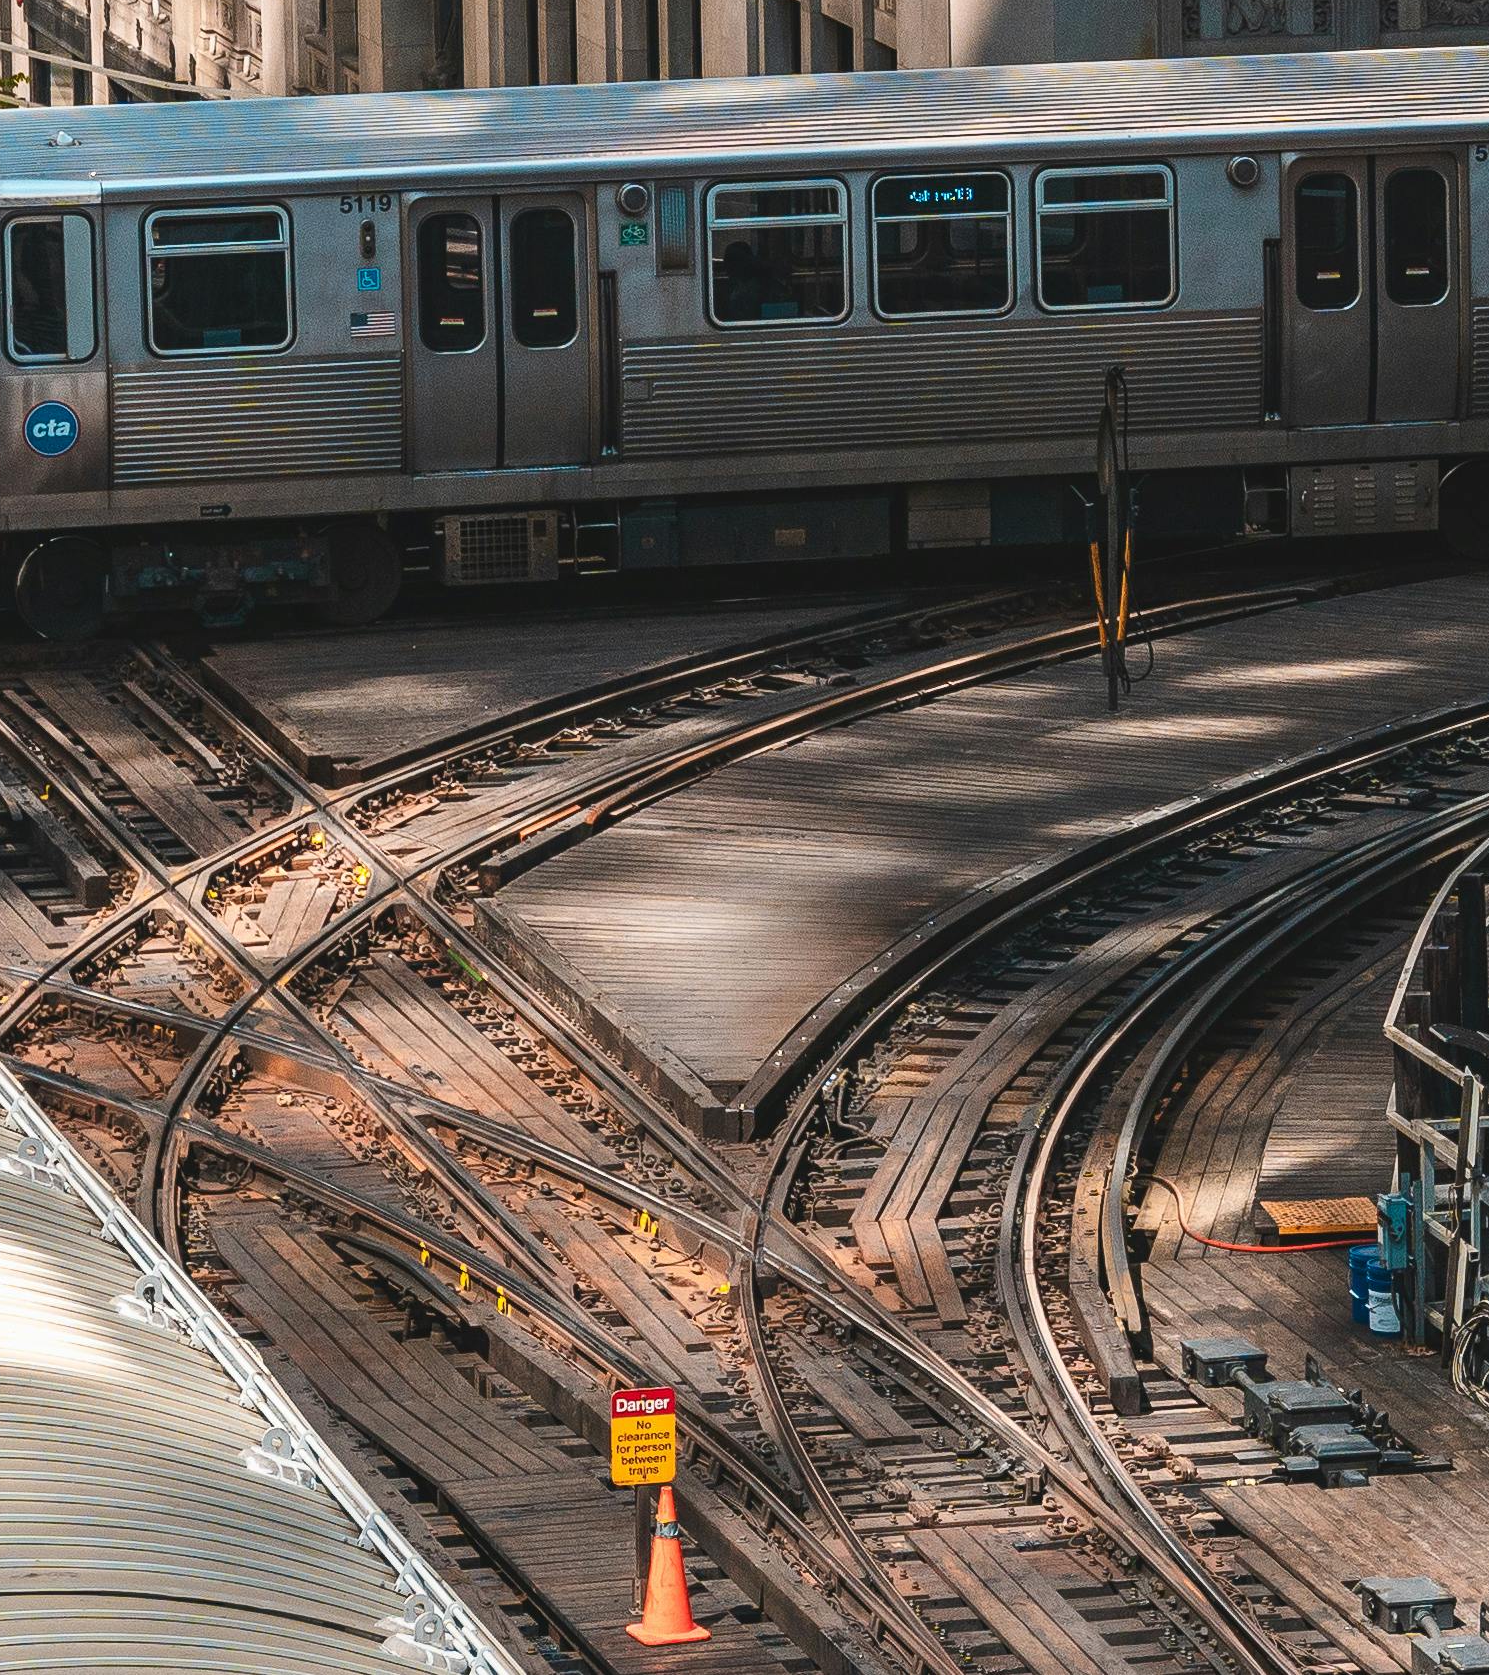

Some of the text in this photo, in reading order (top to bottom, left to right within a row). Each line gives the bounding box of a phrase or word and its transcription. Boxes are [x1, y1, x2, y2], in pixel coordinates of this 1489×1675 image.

[339, 194, 392, 214] 5119
[33, 419, 70, 437] cta
[616, 1397, 670, 1414] Danger
[636, 1421, 652, 1430] No
[617, 1431, 670, 1442] clearance
[616, 1443, 672, 1455] for person
[621, 1455, 667, 1465] between
[628, 1466, 659, 1476] trains
